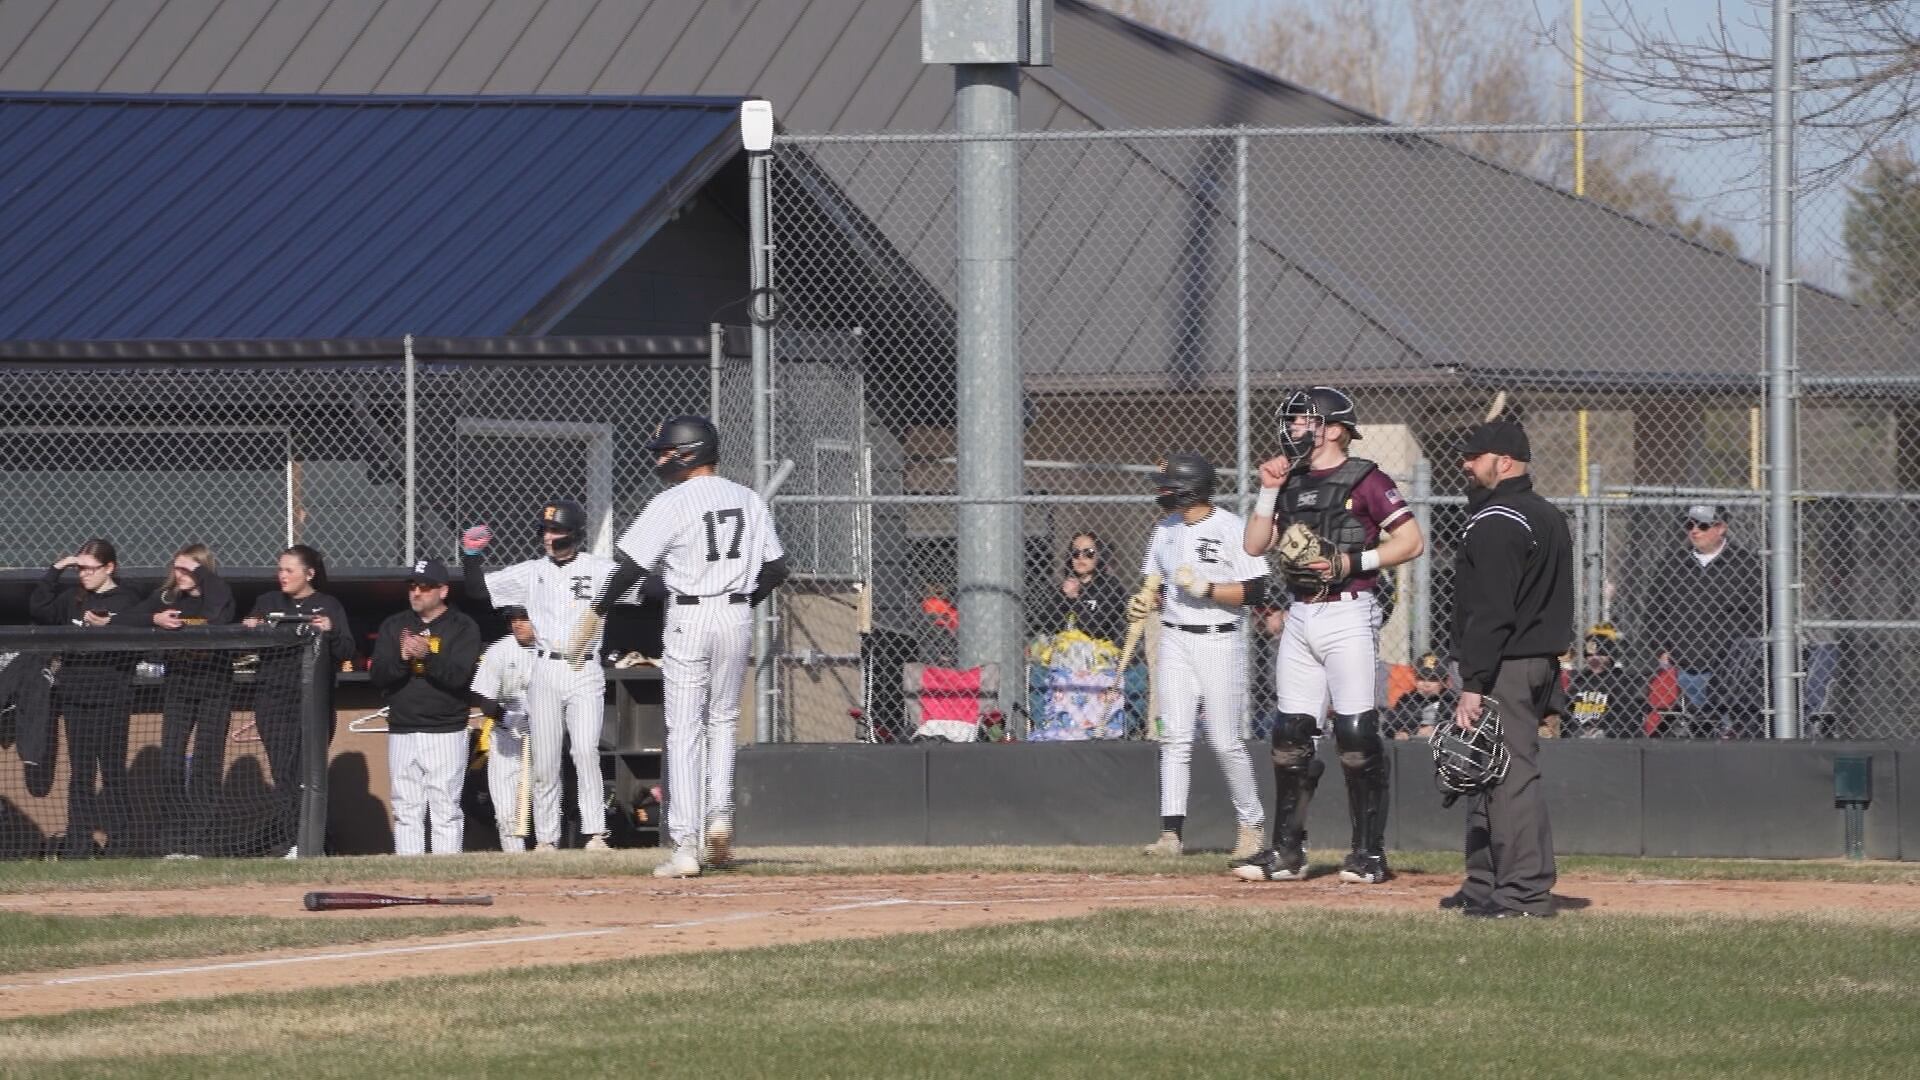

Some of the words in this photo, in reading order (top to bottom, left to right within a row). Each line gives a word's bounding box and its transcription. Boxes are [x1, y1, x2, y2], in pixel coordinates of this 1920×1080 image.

[702, 508, 745, 561] 17
[1195, 537, 1223, 563] E
[415, 561, 428, 573] E
[569, 576, 592, 600] E
